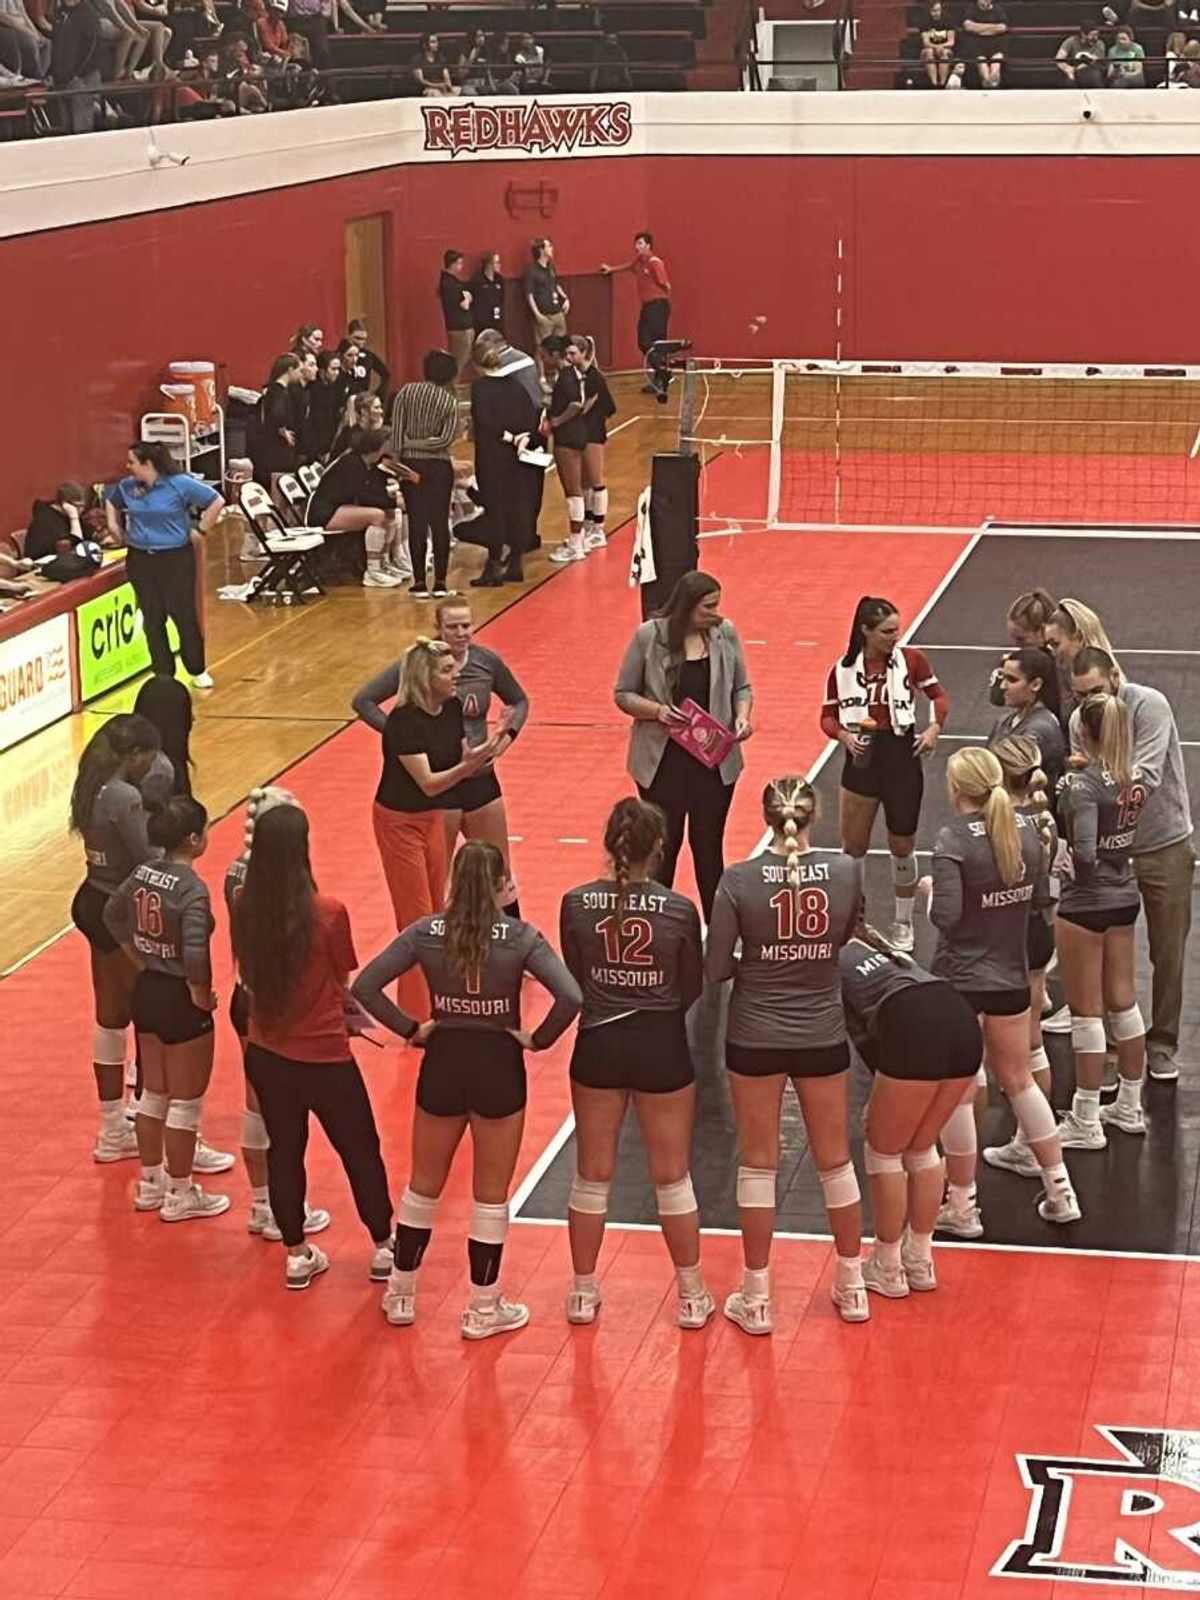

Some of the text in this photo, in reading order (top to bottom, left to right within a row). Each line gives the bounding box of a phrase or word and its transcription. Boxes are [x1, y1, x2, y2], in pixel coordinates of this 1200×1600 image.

[421, 100, 633, 158] REDHAWKS
[91, 596, 135, 660] cric
[133, 886, 163, 937] 16
[582, 892, 668, 914] SOUTEAST
[770, 887, 829, 940] 18
[981, 884, 1034, 908] MISSOU
[595, 914, 654, 966] 12
[761, 943, 832, 961] MISSOURI
[590, 967, 664, 988] MISSOURI
[434, 994, 511, 1016] MISSOURI
